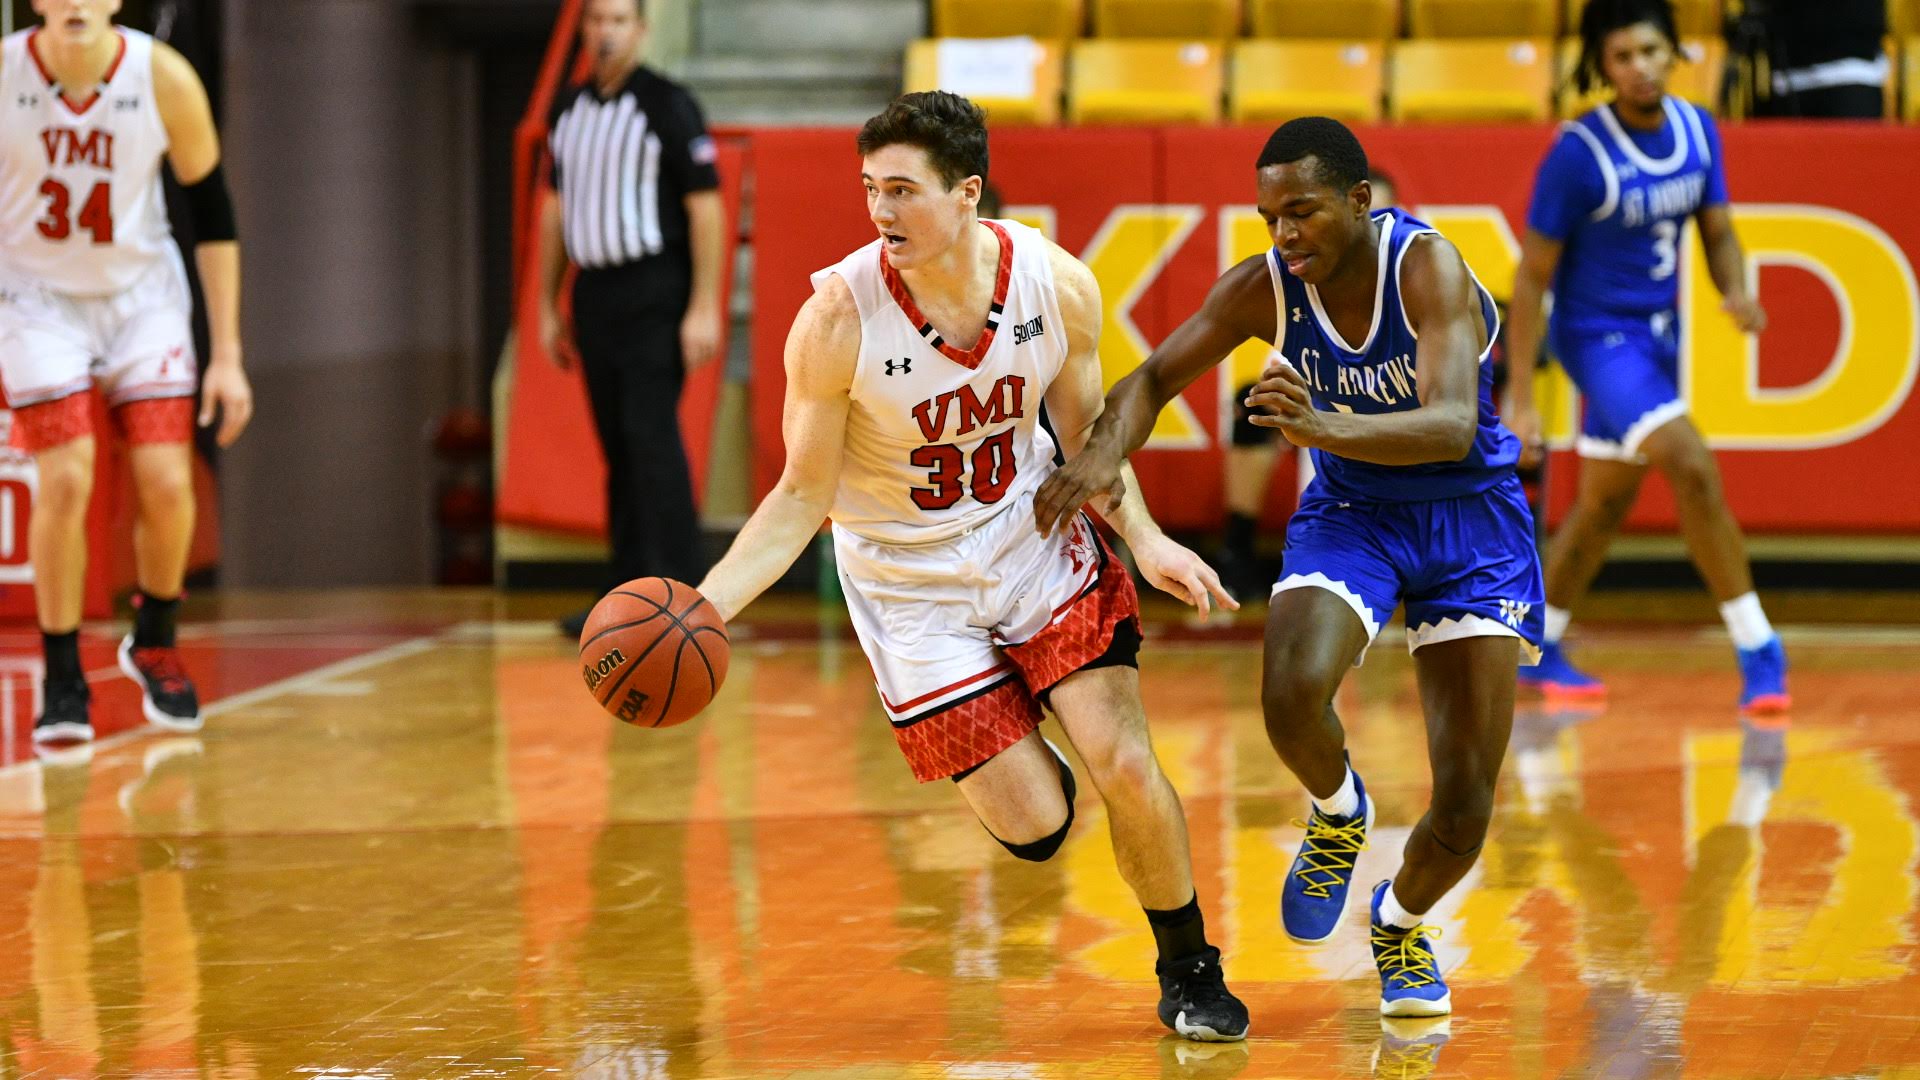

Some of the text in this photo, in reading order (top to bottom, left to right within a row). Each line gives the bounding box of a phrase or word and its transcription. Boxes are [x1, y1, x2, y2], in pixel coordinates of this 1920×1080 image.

[40, 127, 114, 170] VMI
[36, 178, 114, 243] 34
[1650, 218, 1679, 281] 3
[1301, 347, 1417, 405] ST. ADREWS
[912, 375, 1025, 442] VMI
[910, 427, 1017, 510] 30
[583, 647, 626, 692] ilson
[615, 687, 649, 722] CAA
